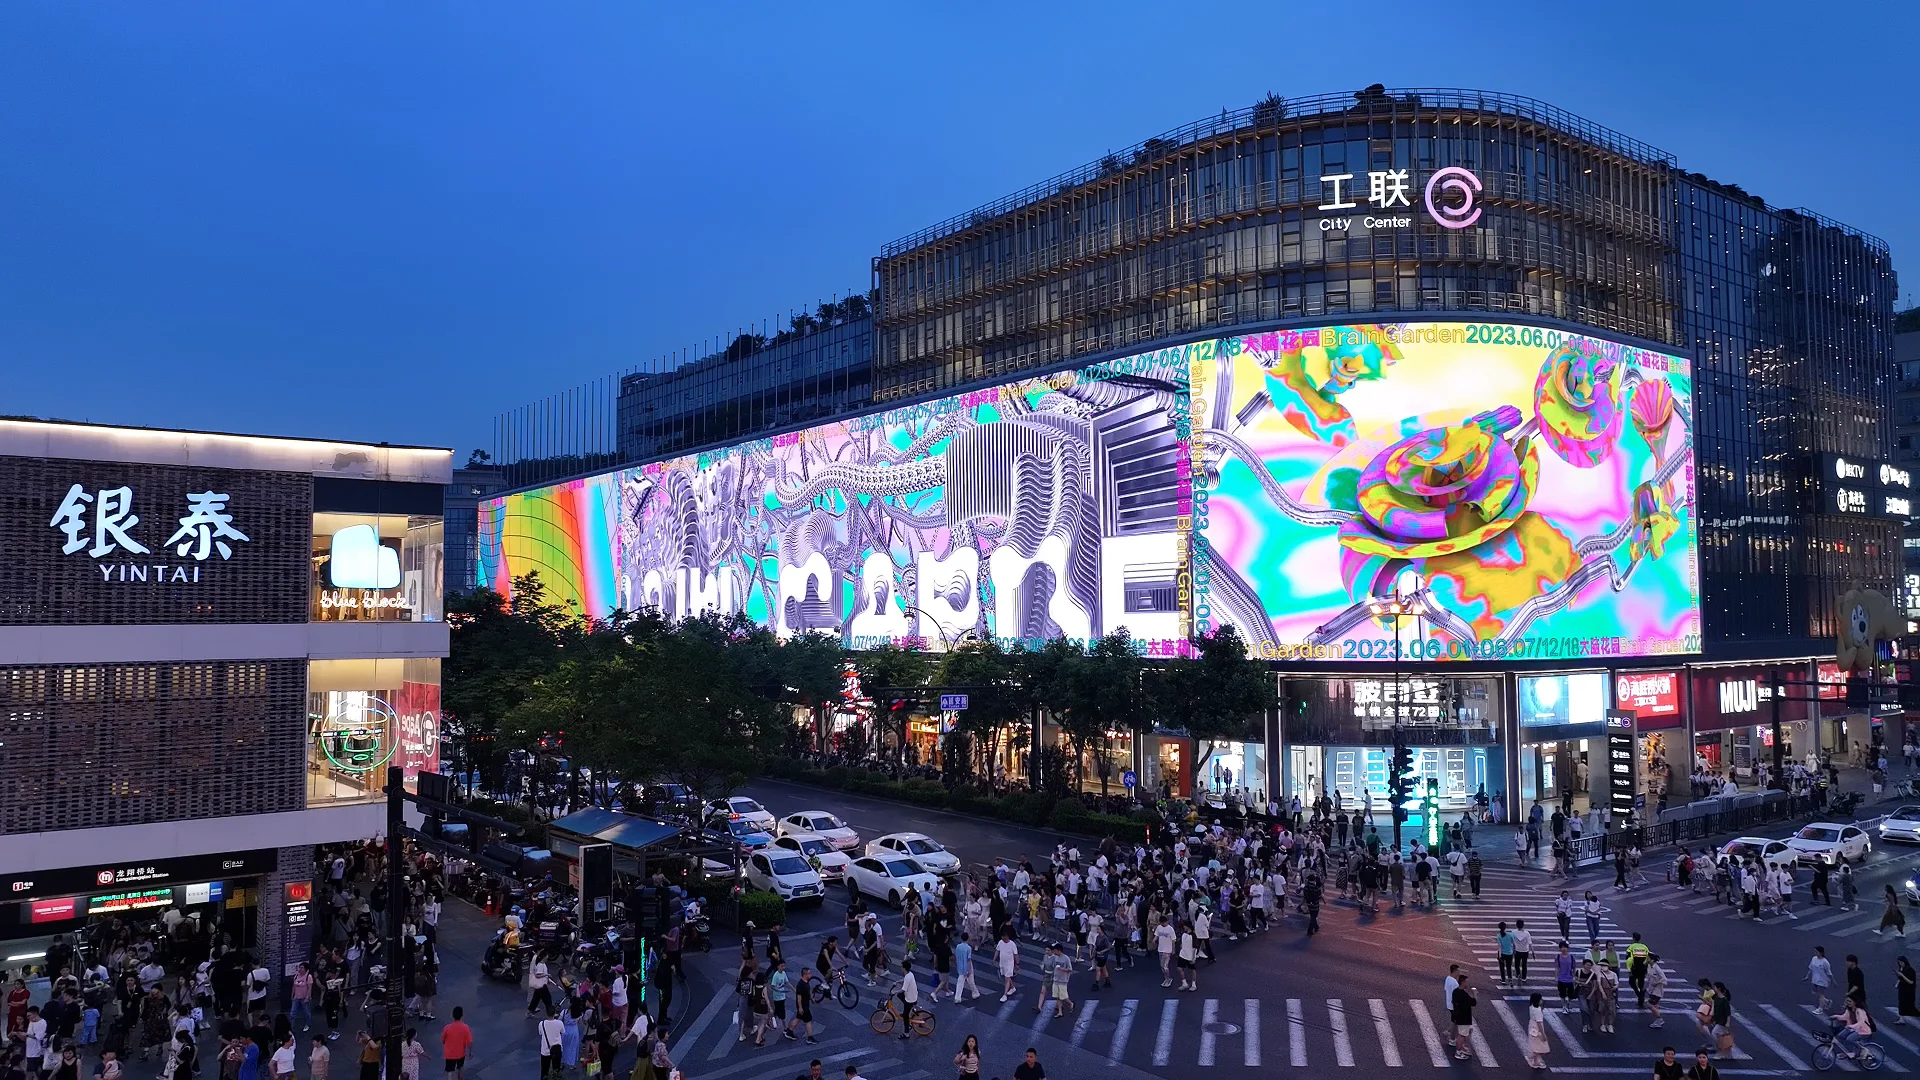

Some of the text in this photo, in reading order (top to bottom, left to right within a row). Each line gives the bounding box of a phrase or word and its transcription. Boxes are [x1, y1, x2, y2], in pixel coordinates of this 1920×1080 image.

[1318, 168, 1411, 210] 工联
[1319, 215, 1411, 232] City Center
[1241, 327, 1320, 353] 大脑花园
[1383, 323, 1465, 346] Garden
[50, 483, 250, 561] 银泰
[99, 564, 200, 583] YINTAI
[320, 590, 411, 608] blue block
[1259, 639, 1342, 659] Garden
[1580, 637, 1620, 655] 大脑花园
[1354, 682, 1440, 704] 波司登
[1720, 680, 1757, 714] MUJI
[116, 867, 155, 878] 龙翔桥站
